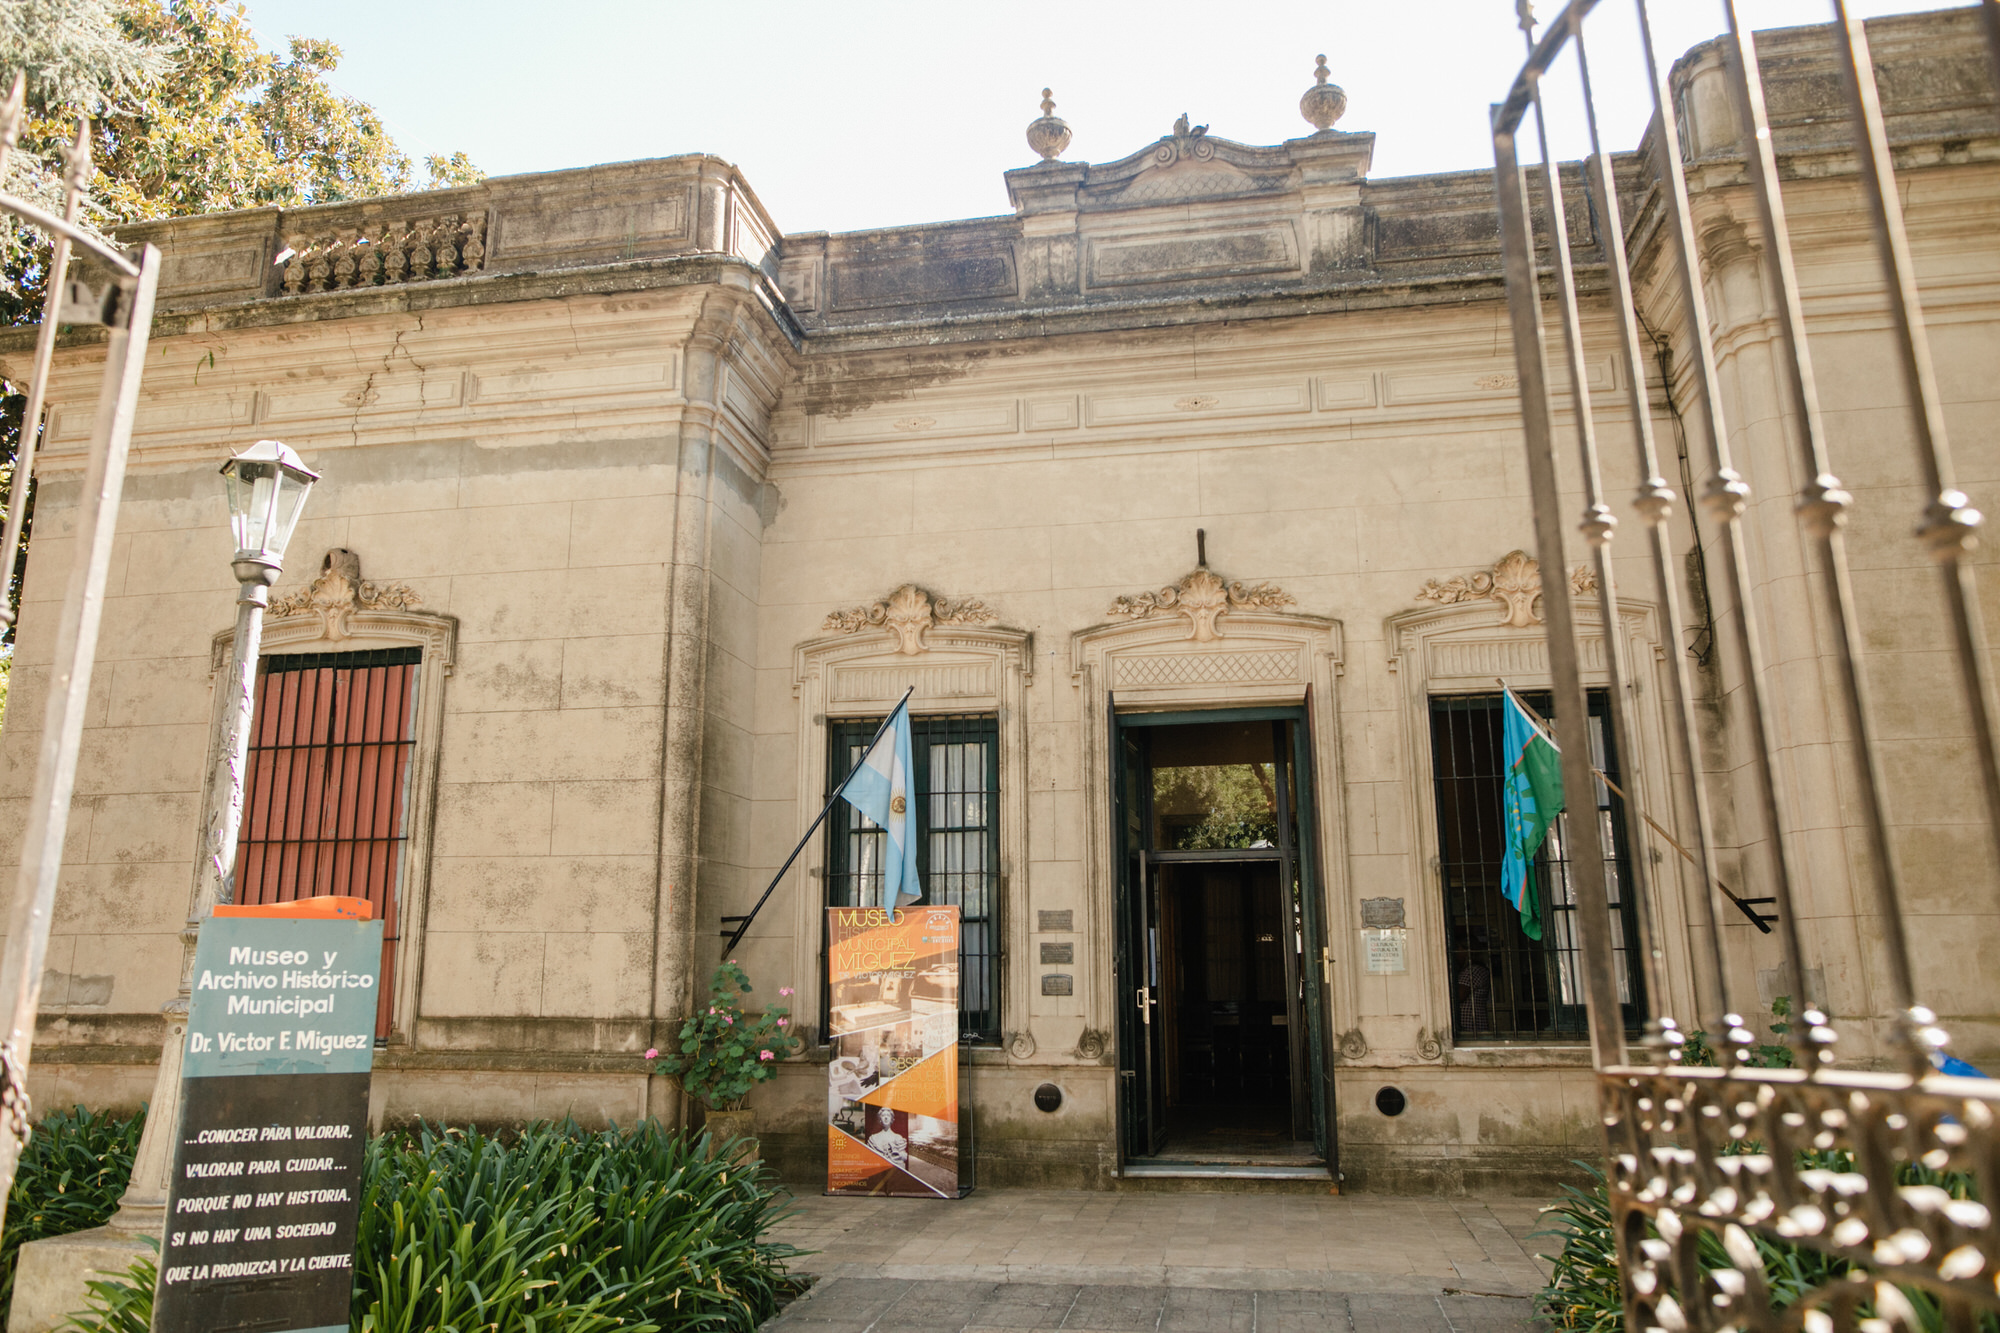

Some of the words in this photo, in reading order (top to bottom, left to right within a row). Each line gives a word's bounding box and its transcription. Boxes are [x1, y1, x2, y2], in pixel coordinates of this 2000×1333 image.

[838, 910, 905, 927] MUSEO
[838, 938, 916, 951] MUNICIPAL
[229, 946, 309, 966] Museo
[323, 951, 337, 969] y
[838, 952, 917, 970] MIGUEZ
[197, 970, 278, 990] Archivo
[281, 970, 374, 989] Histórico
[227, 994, 335, 1018] Municipal
[190, 1032, 212, 1053] Dr.
[217, 1032, 275, 1053] Victor
[296, 1030, 368, 1056] Miguez
[184, 1127, 258, 1145] ...CONOCER
[260, 1126, 291, 1142] PARA
[185, 1161, 244, 1179] VALORAR
[247, 1159, 281, 1175] PARA
[285, 1157, 347, 1173] CUIDAR...
[176, 1194, 231, 1215] PORQUE
[232, 1193, 252, 1209] NO
[255, 1192, 284, 1208] HAY
[171, 1231, 186, 1247] SI
[189, 1230, 209, 1246] NO
[212, 1228, 240, 1244] HAY
[243, 1226, 272, 1242] UNA
[275, 1221, 337, 1239] SOCIEDAD
[165, 1265, 193, 1285] QUE
[193, 1264, 209, 1280] LA
[211, 1259, 277, 1279] PRODUZCA
[280, 1258, 290, 1273] Y
[290, 1256, 306, 1272] LA
